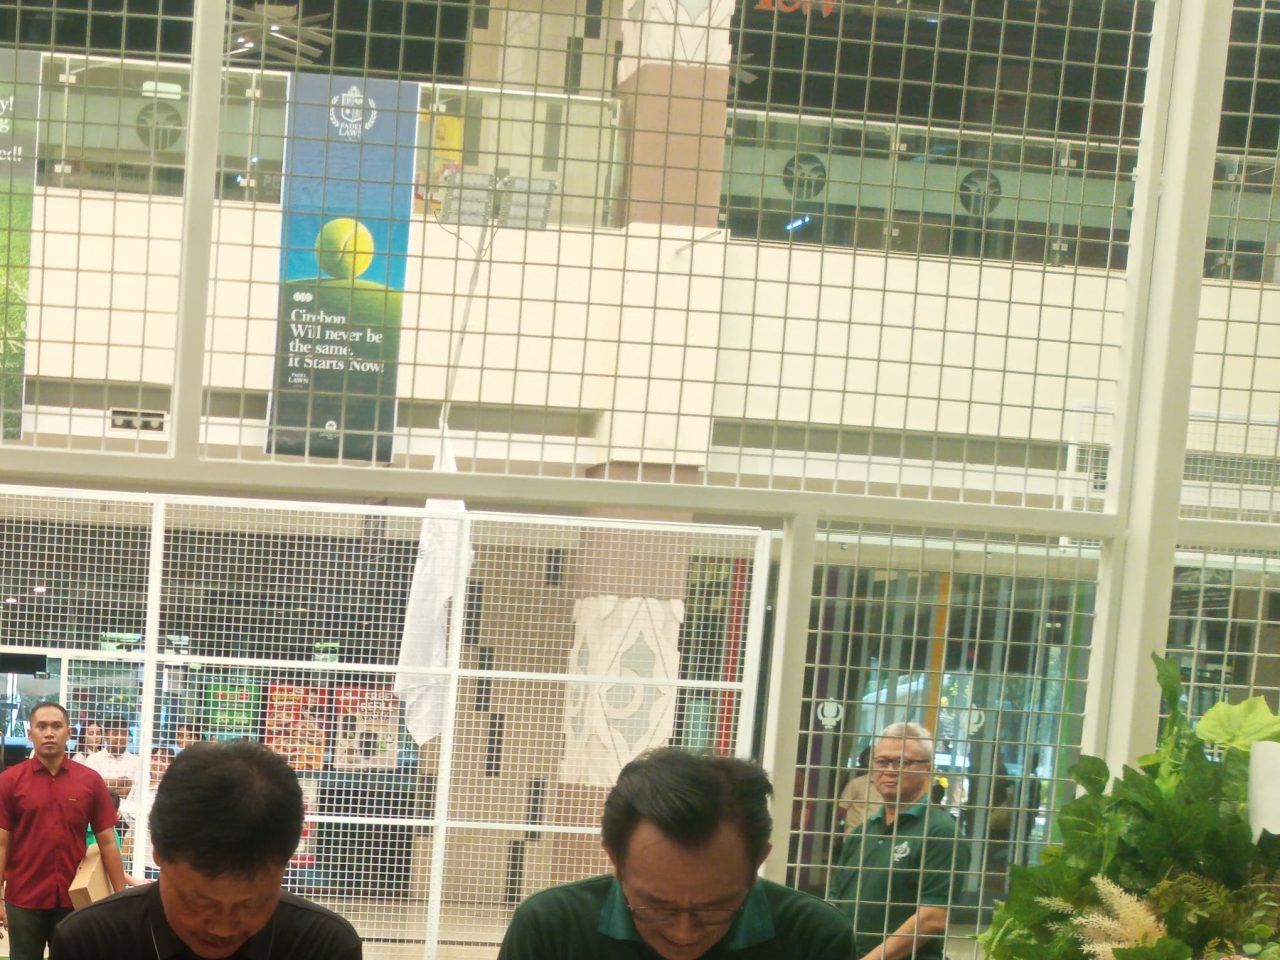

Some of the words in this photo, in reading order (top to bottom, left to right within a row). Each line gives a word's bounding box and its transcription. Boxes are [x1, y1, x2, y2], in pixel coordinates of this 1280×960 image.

[290, 323, 322, 339] Will
[324, 328, 363, 342] never
[366, 328, 384, 343] be
[289, 338, 313, 354] the
[315, 343, 354, 356] same.
[287, 353, 300, 367] It
[303, 354, 345, 370] Starts
[348, 357, 385, 374] Now!
